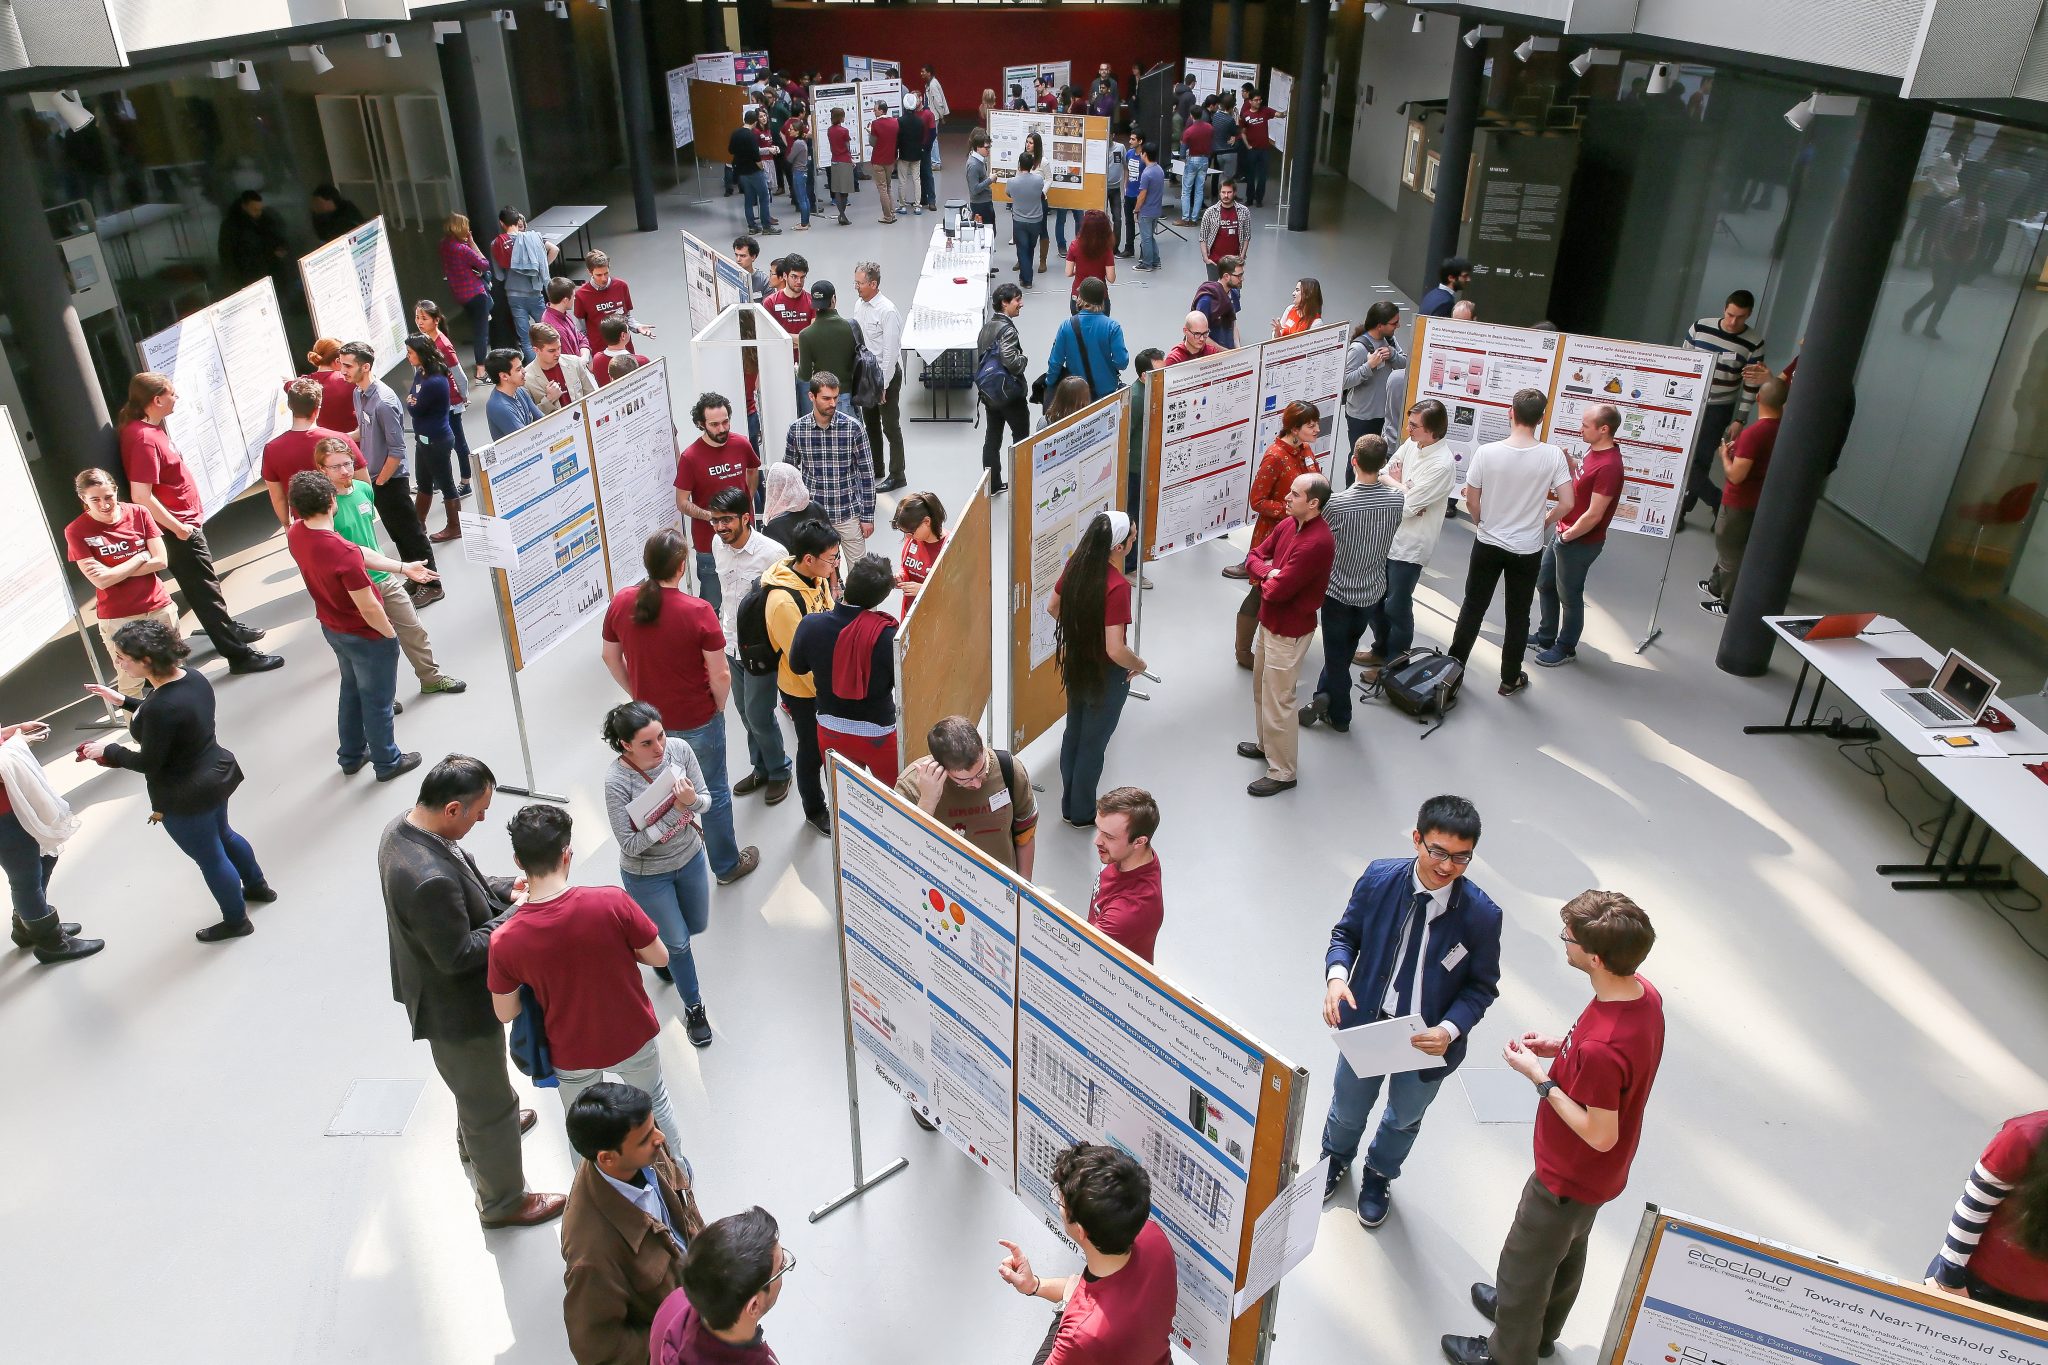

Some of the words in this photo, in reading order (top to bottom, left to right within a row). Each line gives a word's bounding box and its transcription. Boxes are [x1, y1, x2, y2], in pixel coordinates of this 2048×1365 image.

[596, 301, 614, 312] EDIC
[708, 463, 731, 476] EDIC
[99, 541, 130, 556] EDIC
[904, 556, 924, 571] EDIC
[925, 840, 955, 866] Scale-Out
[955, 861, 977, 882] NUMA
[1033, 913, 1081, 952] ecocloud
[1080, 992, 1114, 1020] Application
[1113, 1014, 1126, 1028] and
[1126, 1022, 1160, 1054] technology
[1159, 1047, 1181, 1069] trends
[1099, 963, 1117, 981] Chip
[1118, 975, 1144, 1000] Design
[1145, 995, 1157, 1008] for
[1159, 1004, 1200, 1040] Rack-Scale
[1202, 1035, 1250, 1076] Computing
[875, 1063, 902, 1094] Research
[1093, 1054, 1124, 1084] placement
[1123, 1078, 1168, 1117] considerations
[1039, 1110, 1051, 1122] Our
[1045, 1217, 1079, 1254] Research
[1160, 1212, 1192, 1244] Evaluation
[1688, 1249, 1793, 1287] ecocloud
[1699, 1262, 1719, 1273] EPFL
[1720, 1269, 1757, 1285] research
[1758, 1281, 1786, 1293] center
[1688, 1312, 1716, 1327] Cloud
[1718, 1322, 1754, 1340] Services
[1766, 1338, 1823, 1361] Datacenters
[1747, 1296, 1772, 1308] Andrea
[1811, 1316, 1830, 1327] Pablo
[1841, 1325, 1852, 1334] del
[1875, 1336, 1896, 1347] David
[1929, 1354, 1946, 1364] Luca
[1790, 1303, 1809, 1312] Javier
[1935, 1348, 1961, 1360] Davide
[1803, 1287, 1865, 1315] Towards
[1869, 1308, 1995, 1355] Near-Threshold
